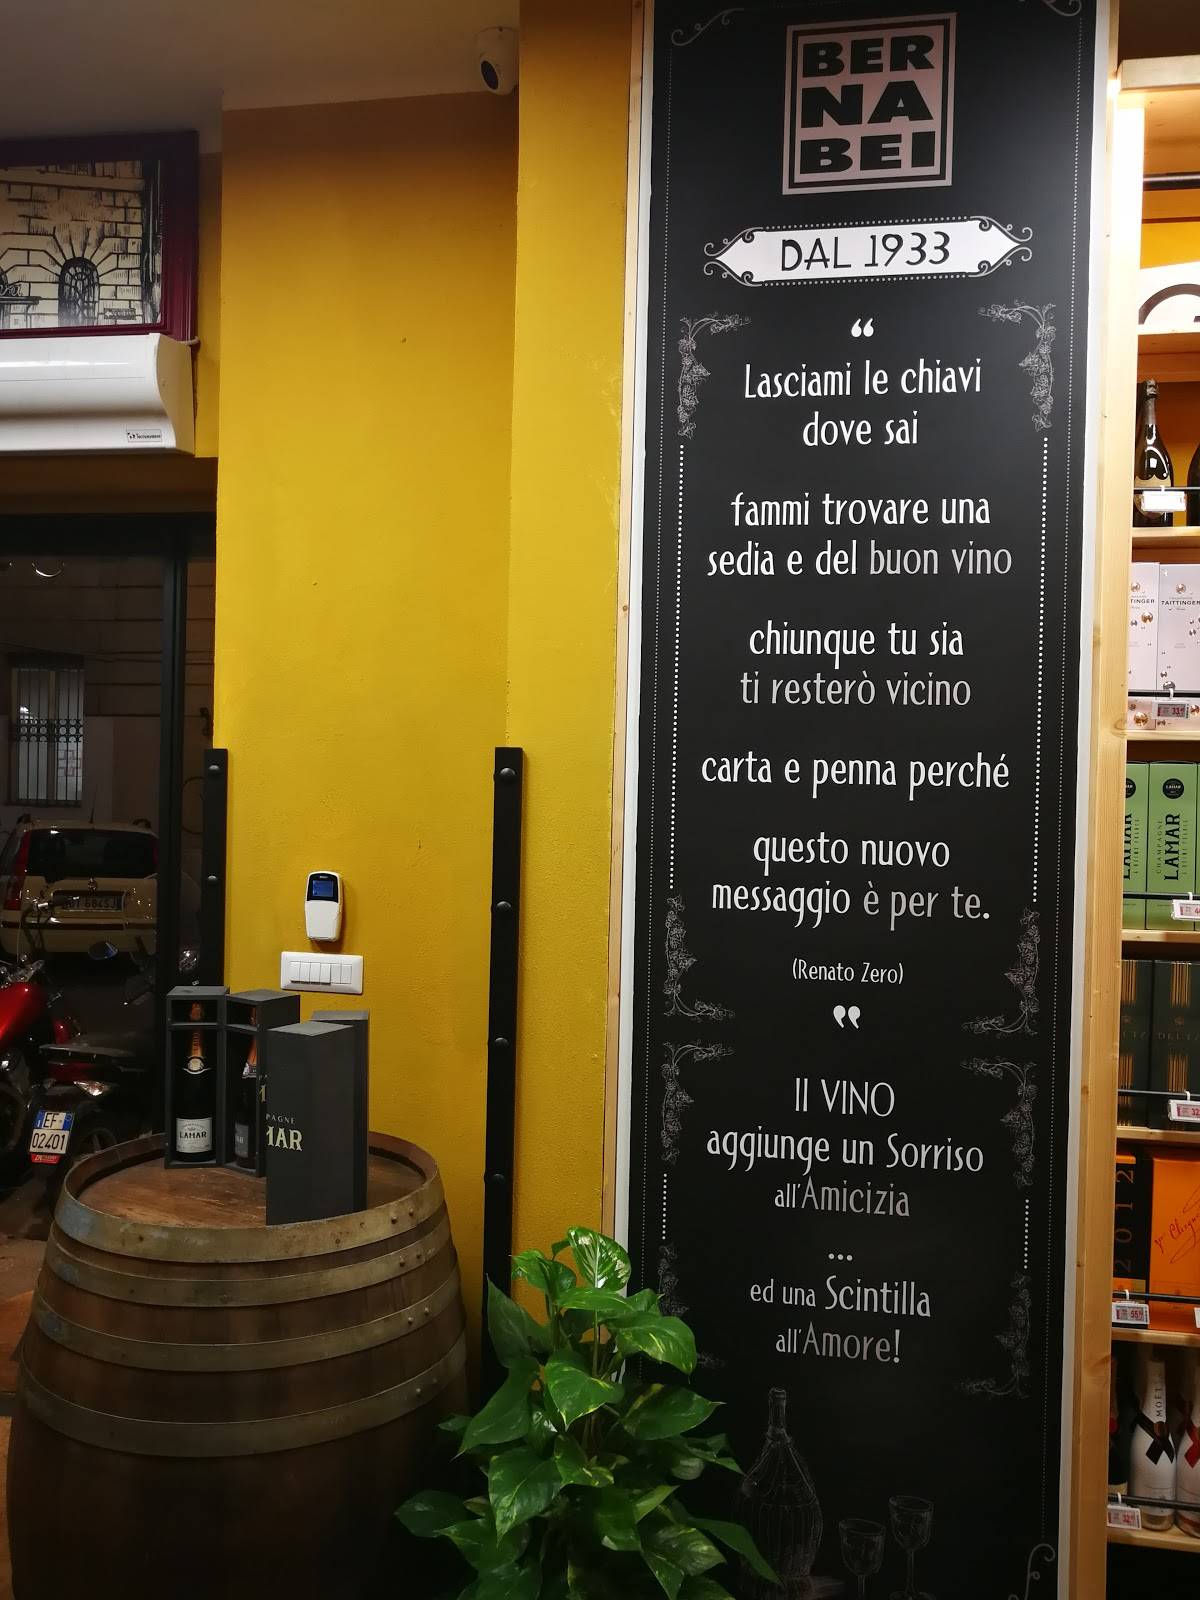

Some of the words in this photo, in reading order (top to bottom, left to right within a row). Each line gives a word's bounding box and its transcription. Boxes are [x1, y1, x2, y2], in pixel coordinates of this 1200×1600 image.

[801, 36, 936, 78] BER
[800, 80, 934, 128] NA
[799, 130, 936, 175] BEI
[780, 235, 852, 272] DAL
[863, 231, 951, 268] 1933
[745, 362, 851, 398] Lasciami
[865, 360, 888, 395] le
[901, 358, 981, 393] chiavi
[803, 411, 871, 446] dove
[884, 410, 917, 445] sai
[731, 492, 809, 526] fammi
[822, 493, 928, 525] trovare
[942, 498, 990, 524] una
[707, 541, 774, 576] sedia
[787, 551, 803, 575] e
[816, 540, 856, 575] del
[870, 540, 938, 574] buon
[952, 541, 1012, 574] vino
[750, 620, 875, 669] chiunque
[888, 623, 916, 655] tu
[929, 622, 963, 655] sia
[740, 671, 759, 703] ti
[772, 671, 875, 705] resterò
[886, 672, 970, 705] vicino
[702, 751, 772, 783] carta
[785, 759, 800, 783] e
[813, 760, 896, 798] penna
[909, 752, 1009, 801] perché
[754, 832, 848, 876] questo
[862, 840, 949, 867] nuovo
[1164, 813, 1181, 881] LAMAR
[713, 881, 850, 928] messaggio
[864, 881, 879, 915] è
[890, 891, 939, 931] per
[951, 886, 989, 919] te.
[793, 958, 854, 981] (Renato
[861, 962, 903, 984] Zero)
[796, 1078, 808, 1111] Il
[821, 1079, 894, 1117] VINO
[43, 1112, 60, 1128] EF
[179, 1130, 208, 1140] LAMAR
[31, 1132, 66, 1151] 02401
[707, 1126, 830, 1177] aggiunge
[843, 1139, 873, 1165] un
[886, 1133, 983, 1171] Sorriso
[751, 1279, 773, 1303] ed
[783, 1287, 816, 1307] una
[825, 1275, 930, 1317] Scintilla
